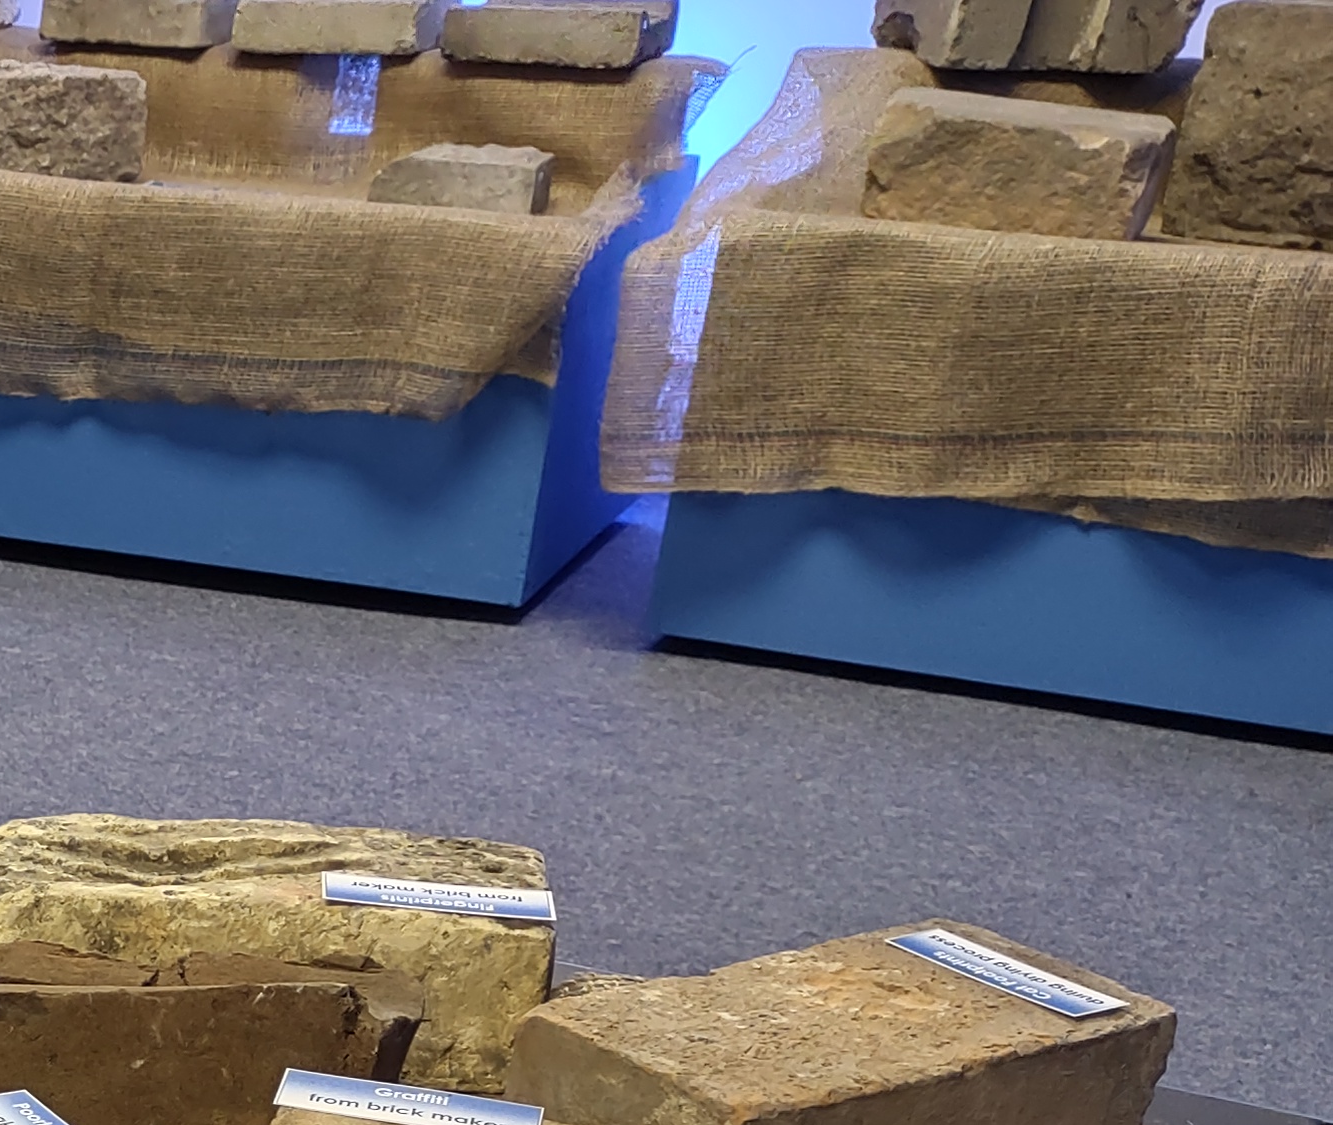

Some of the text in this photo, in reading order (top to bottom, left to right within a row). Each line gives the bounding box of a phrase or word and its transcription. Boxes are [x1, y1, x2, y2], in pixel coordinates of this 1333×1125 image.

[351, 881, 523, 902] from brick maker
[380, 894, 494, 912] Fingerprints
[928, 934, 1105, 1005] during drying process
[933, 951, 1052, 1000] Cat Footprints
[308, 1093, 359, 1108] from
[367, 1102, 424, 1117] brick
[374, 1087, 450, 1106] Graffiti
